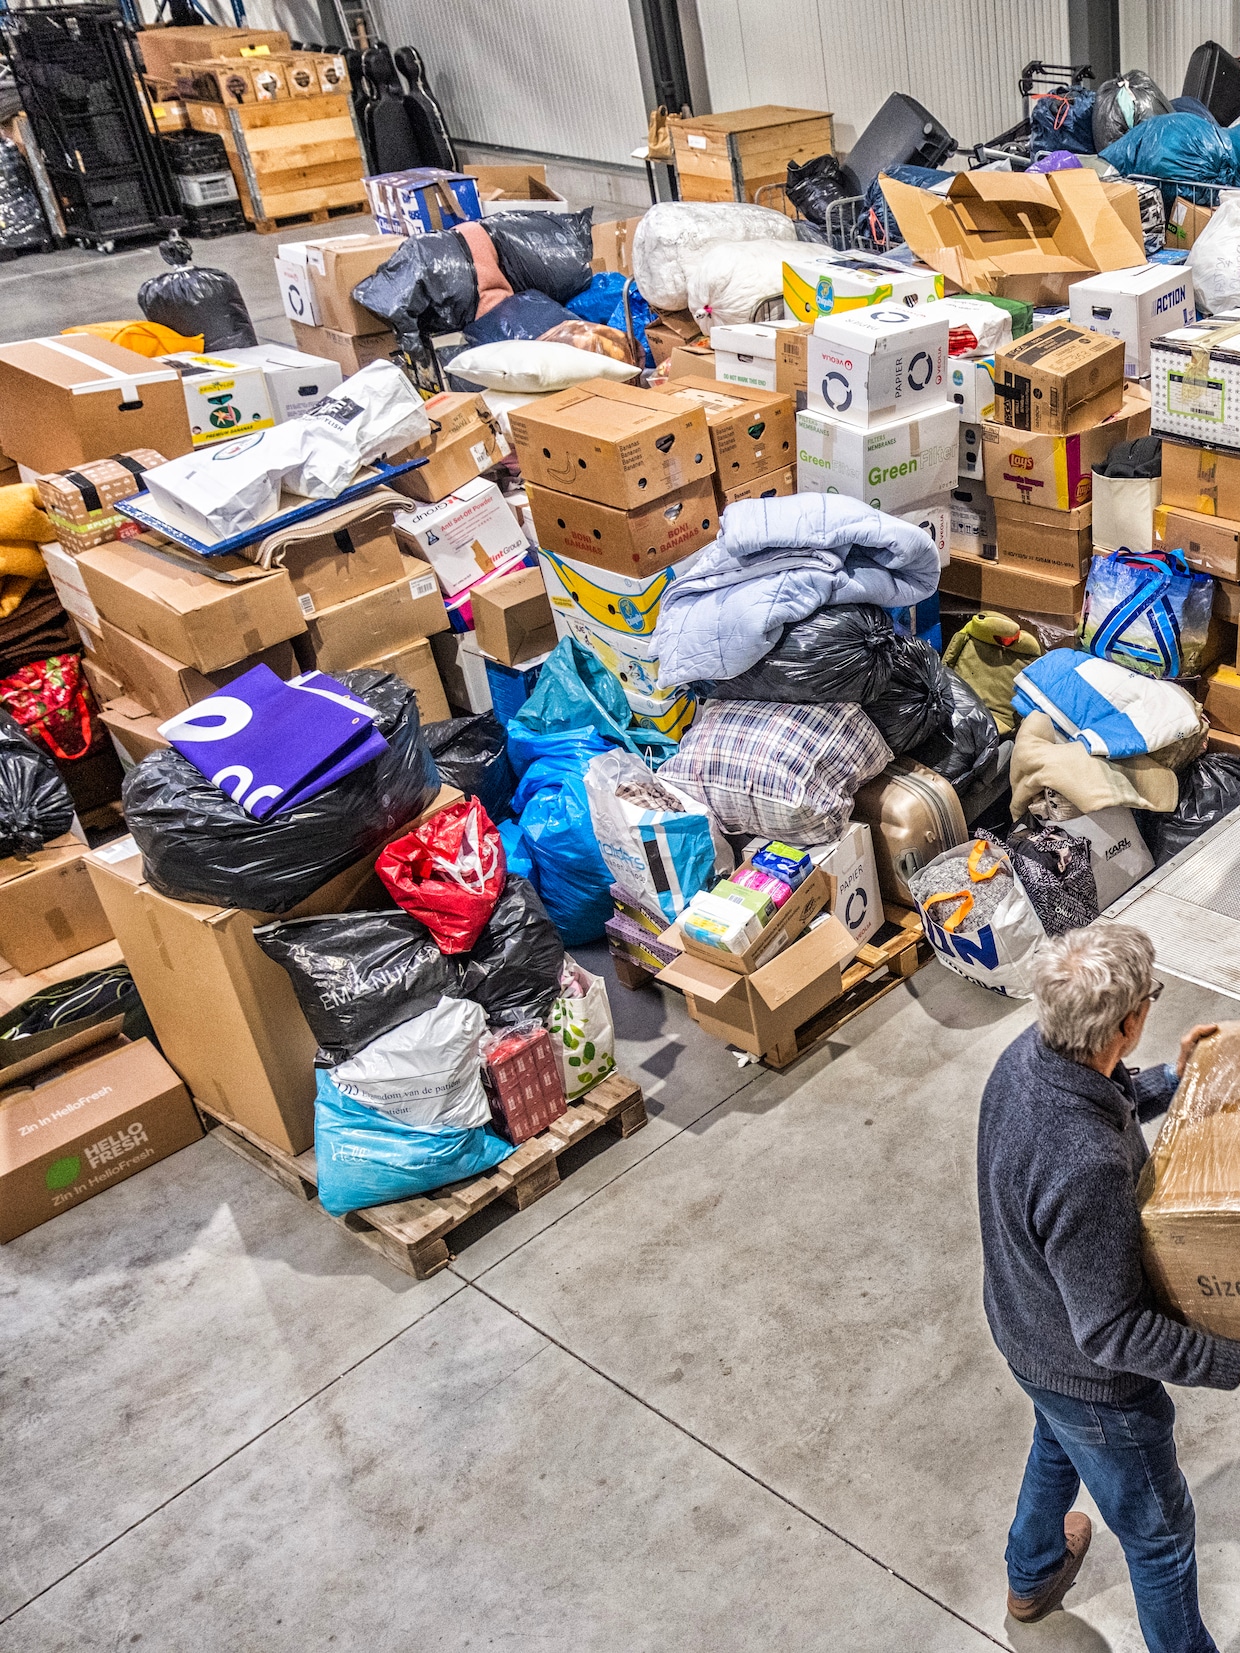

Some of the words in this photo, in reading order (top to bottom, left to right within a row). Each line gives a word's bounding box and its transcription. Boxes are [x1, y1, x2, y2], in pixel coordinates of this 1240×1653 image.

[1156, 284, 1186, 315] ACTION
[822, 353, 844, 366] VEOLIA
[738, 375, 748, 383] MARK
[758, 378, 766, 386] END
[895, 357, 903, 398] PAPIER
[205, 429, 229, 439] PREMIUM
[230, 424, 254, 435] BANANAS
[798, 421, 830, 437] MEMBRANES
[867, 434, 886, 446] FILTERS
[867, 438, 896, 452] MEMBRANES
[799, 449, 831, 470] Green
[868, 458, 917, 487] Green
[919, 443, 959, 470] Filter
[441, 521, 453, 532] Anti
[454, 508, 473, 525] Set-Off
[473, 495, 494, 513] Powder
[572, 531, 592, 544] BONI
[660, 527, 700, 554] BANANAS
[667, 523, 690, 539] BONI
[564, 537, 603, 556] BANANAS
[1104, 837, 1132, 857] KARL
[839, 864, 865, 895] PAPIER
[404, 1089, 420, 1098] van
[422, 1083, 433, 1094] de
[435, 1077, 462, 1093] patiënt
[18, 1123, 39, 1137] Zin
[38, 1115, 51, 1127] In
[51, 1085, 113, 1121] HelloFresh
[385, 1107, 412, 1117] atiënt:
[84, 1121, 144, 1160] HELLO
[88, 1130, 149, 1170] FRESH
[51, 1191, 73, 1207] Zin
[74, 1183, 87, 1195] In
[88, 1147, 155, 1188] HelloFresh
